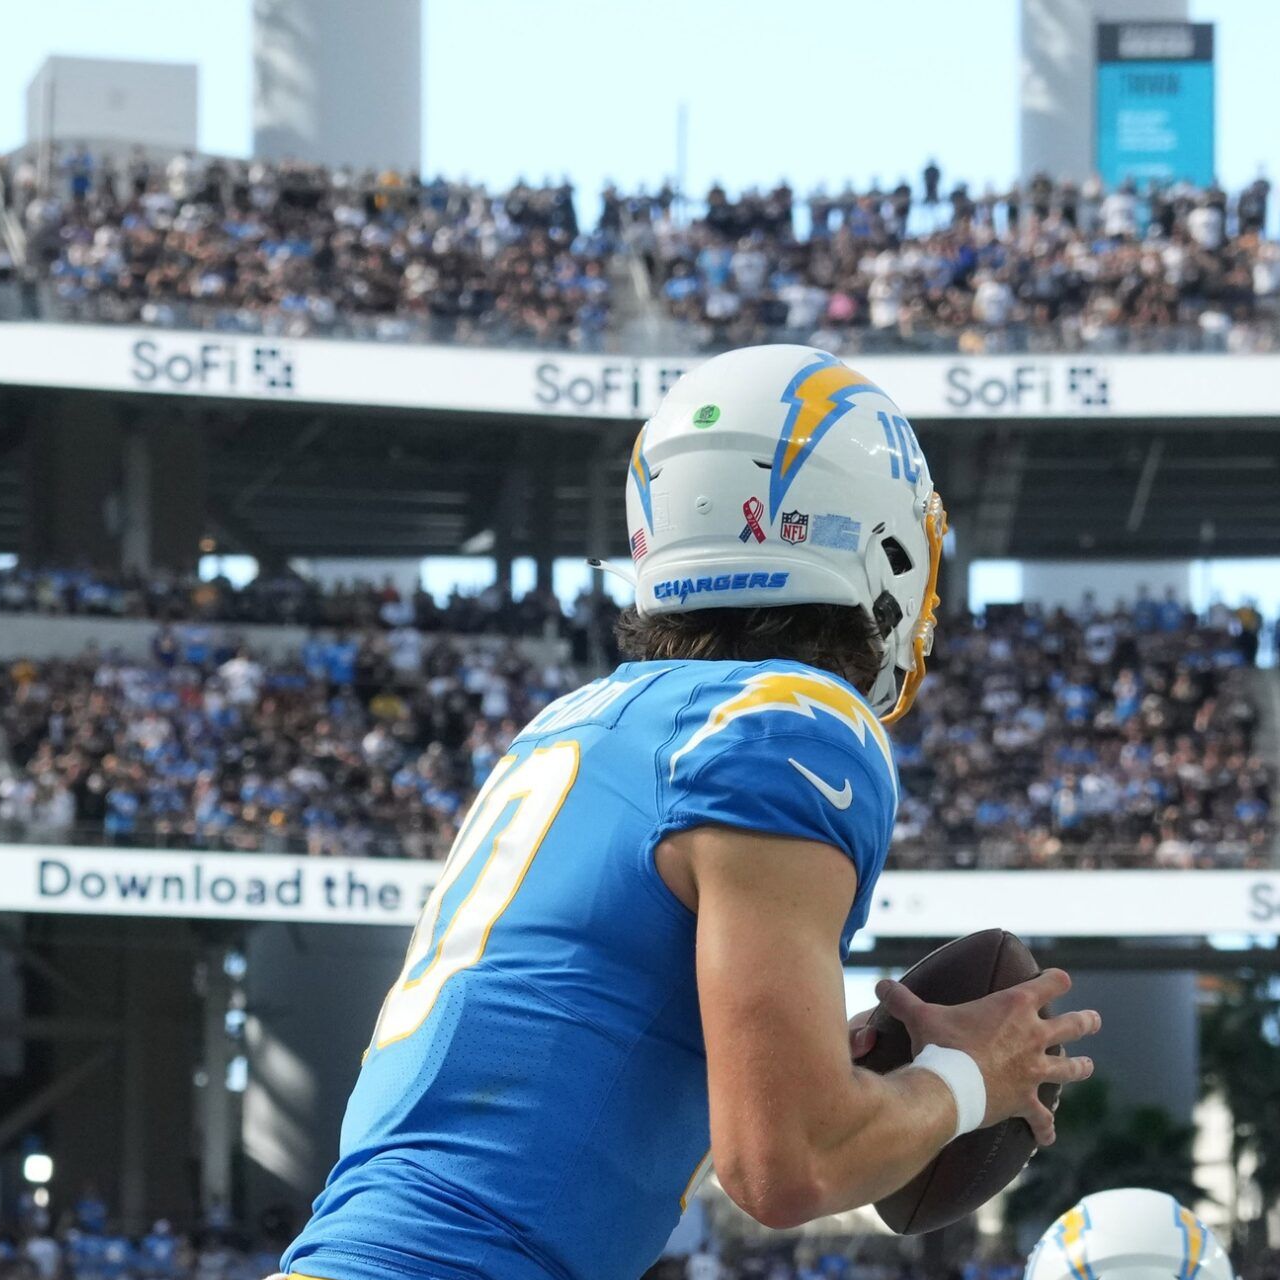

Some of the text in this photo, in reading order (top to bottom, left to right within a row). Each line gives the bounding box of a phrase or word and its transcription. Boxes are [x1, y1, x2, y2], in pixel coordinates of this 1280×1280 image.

[130, 338, 237, 392] SoFi
[535, 361, 641, 409] SoFi
[945, 365, 1052, 409] SoFi
[782, 523, 806, 540] NFL
[654, 572, 790, 605] CHARGERS
[38, 858, 302, 907] Download
[323, 868, 402, 911] the
